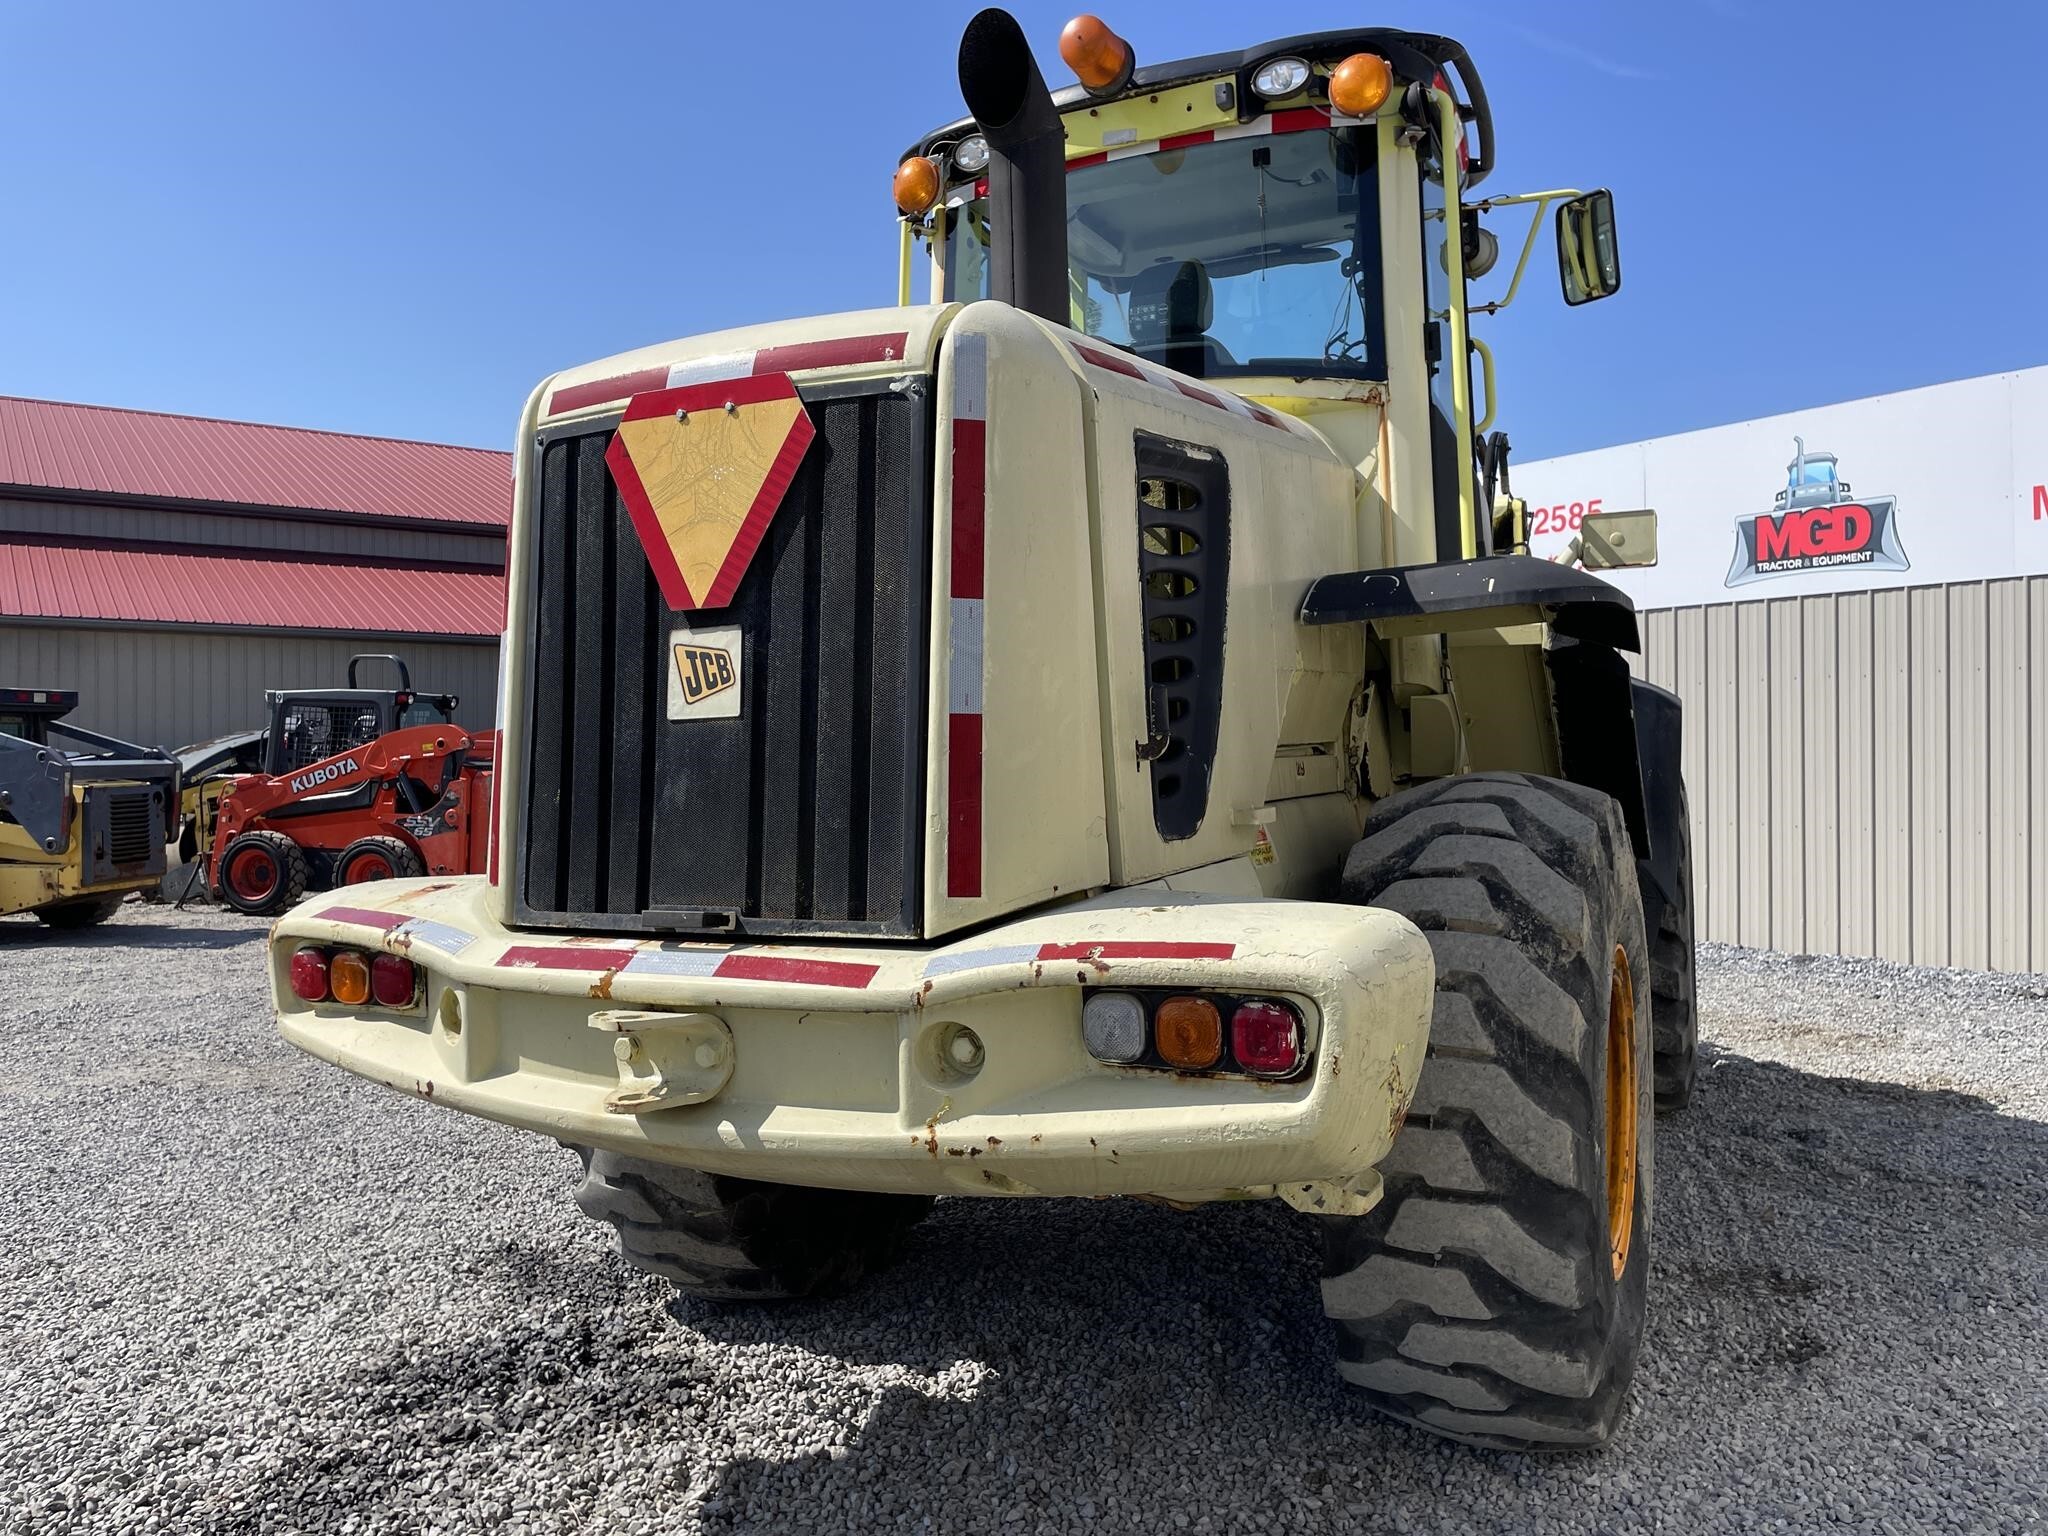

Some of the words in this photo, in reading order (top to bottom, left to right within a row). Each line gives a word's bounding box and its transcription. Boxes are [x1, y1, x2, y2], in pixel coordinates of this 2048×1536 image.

[1756, 504, 1872, 561] MGD
[1757, 559, 1802, 573] TRACTOR
[1803, 558, 1811, 567] &
[1812, 551, 1872, 567] EQUIPMENT
[684, 650, 731, 697] JCB
[291, 758, 359, 793] KUBOTA
[403, 816, 441, 827] SSV
[413, 827, 433, 837] 65
